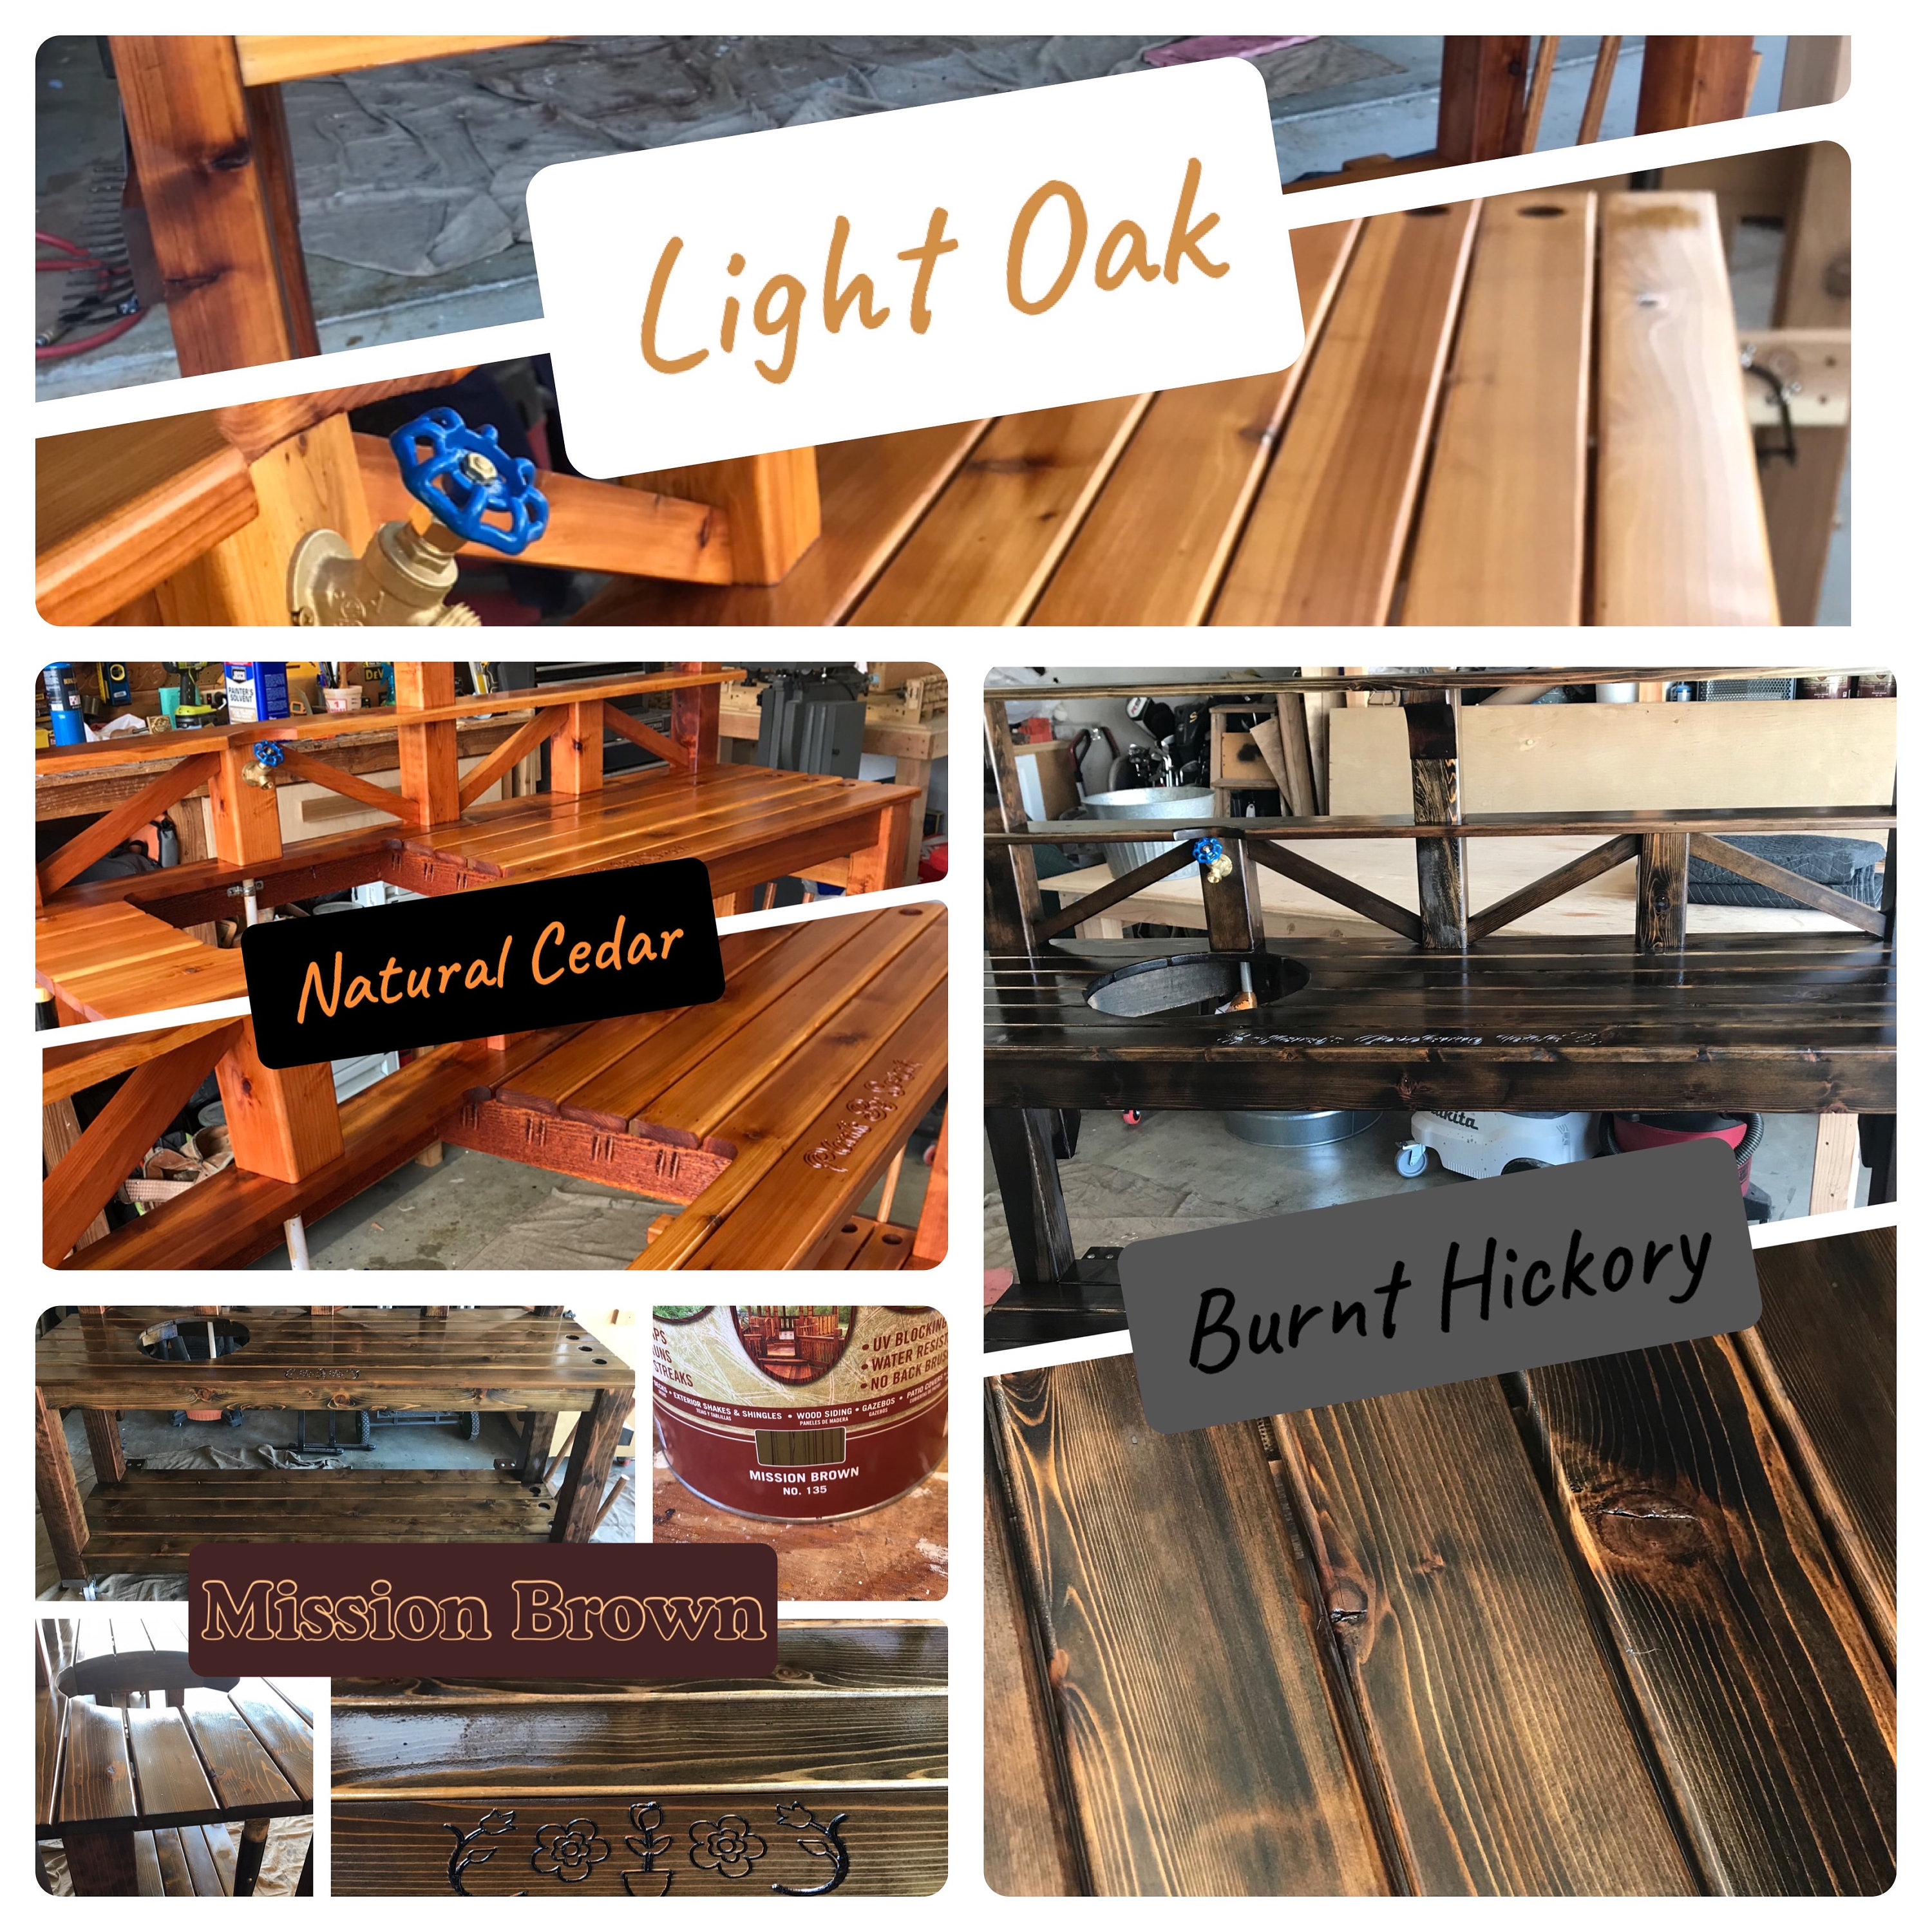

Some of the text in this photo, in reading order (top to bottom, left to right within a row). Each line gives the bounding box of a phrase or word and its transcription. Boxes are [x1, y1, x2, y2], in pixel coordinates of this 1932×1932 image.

[228, 687, 254, 696] PAINTER'S
[230, 694, 252, 703] SOLVENT
[1431, 1110, 1479, 1131] akita
[873, 1334, 891, 1352] UV
[653, 1344, 672, 1363] UNS
[871, 1349, 913, 1372] WATER
[653, 1359, 694, 1387] STREAKS
[871, 1375, 888, 1391] NO
[893, 1363, 922, 1385] BACK
[673, 1392, 701, 1408] EXTERIOR
[703, 1403, 732, 1415] SHAKES
[742, 1410, 782, 1420] SHINGLES
[797, 1411, 822, 1420] WOOD
[824, 1407, 853, 1417] SIDING
[862, 1397, 895, 1412] GAZEBOS
[907, 1385, 924, 1399] PATIO
[869, 1407, 888, 1417] GAZEBOS
[749, 1466, 859, 1483] MISSION BROWN
[783, 1485, 827, 1496] NO. 135
